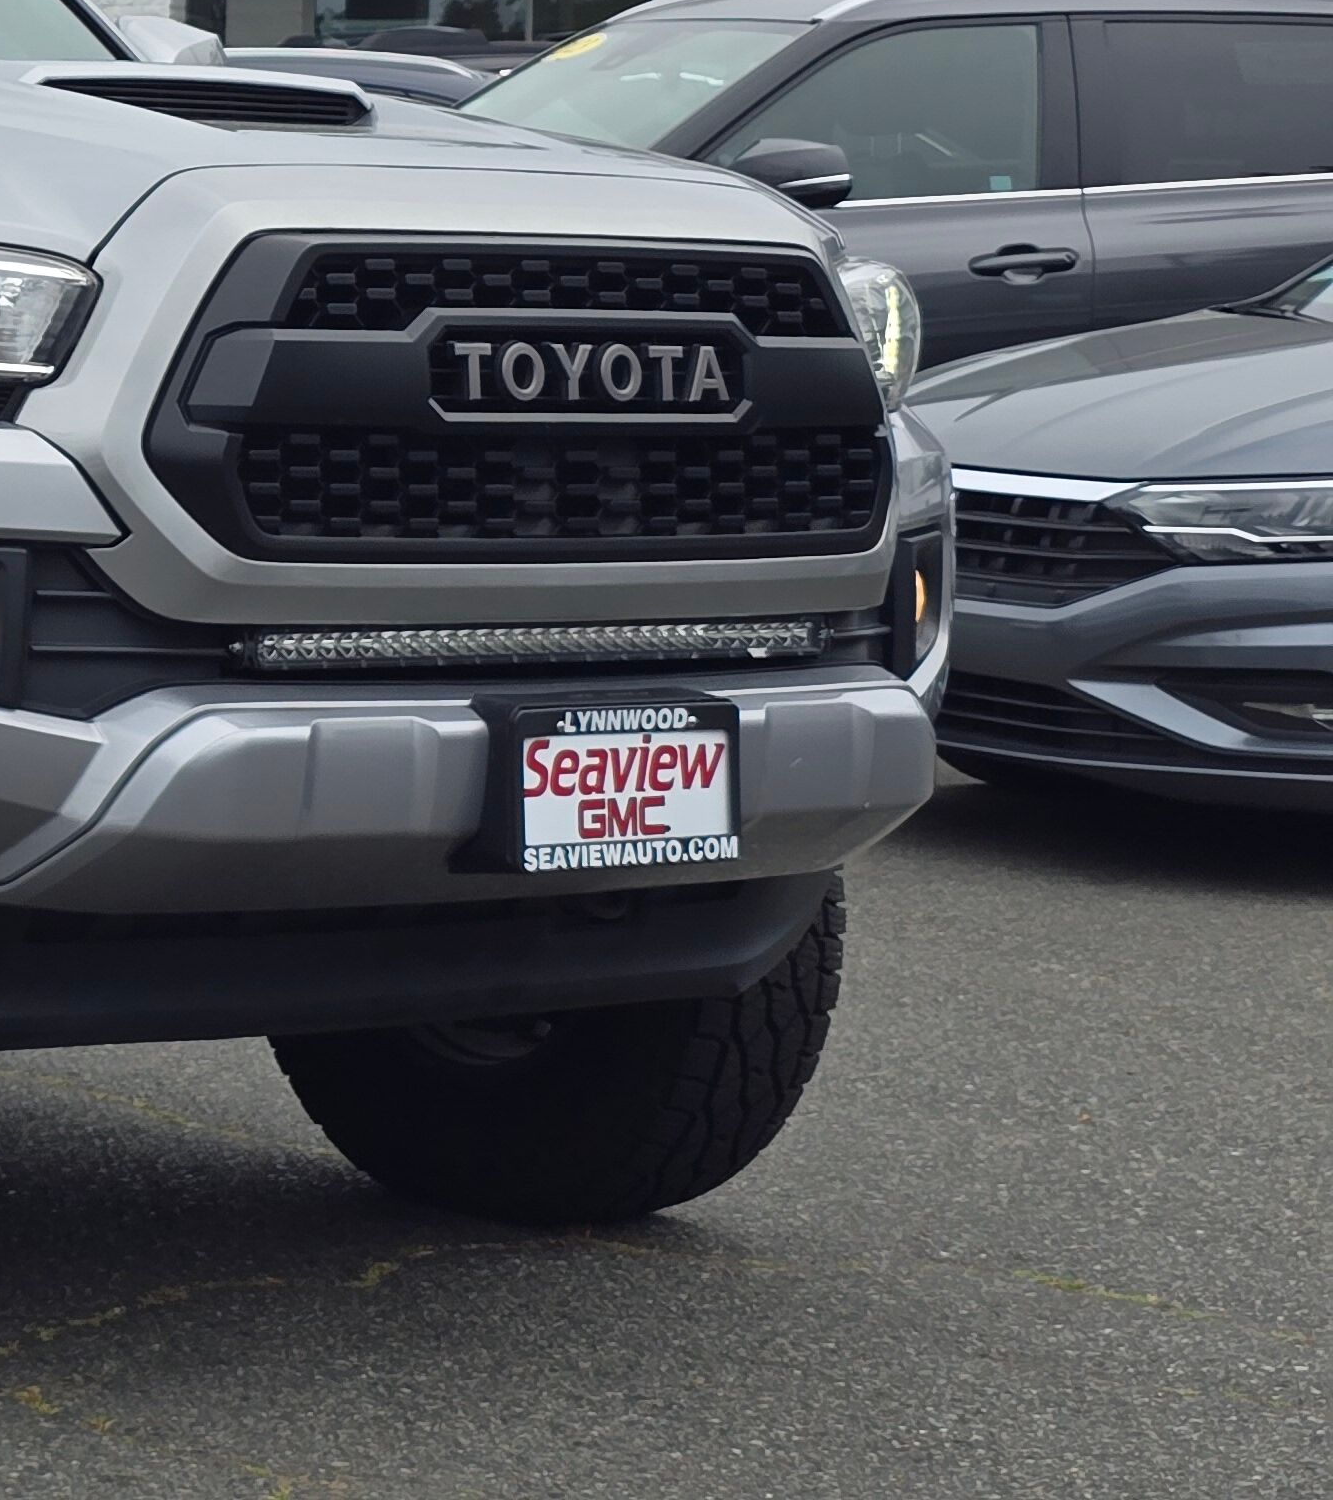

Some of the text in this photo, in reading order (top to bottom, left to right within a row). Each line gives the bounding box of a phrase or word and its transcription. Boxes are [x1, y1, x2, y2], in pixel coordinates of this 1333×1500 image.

[453, 341, 730, 403] TOYOTA
[563, 707, 689, 734] LYNNWOOD
[523, 734, 726, 798] Seaview
[577, 795, 669, 840] GMC
[523, 835, 739, 873] SEAVIEWAUTO.COM
